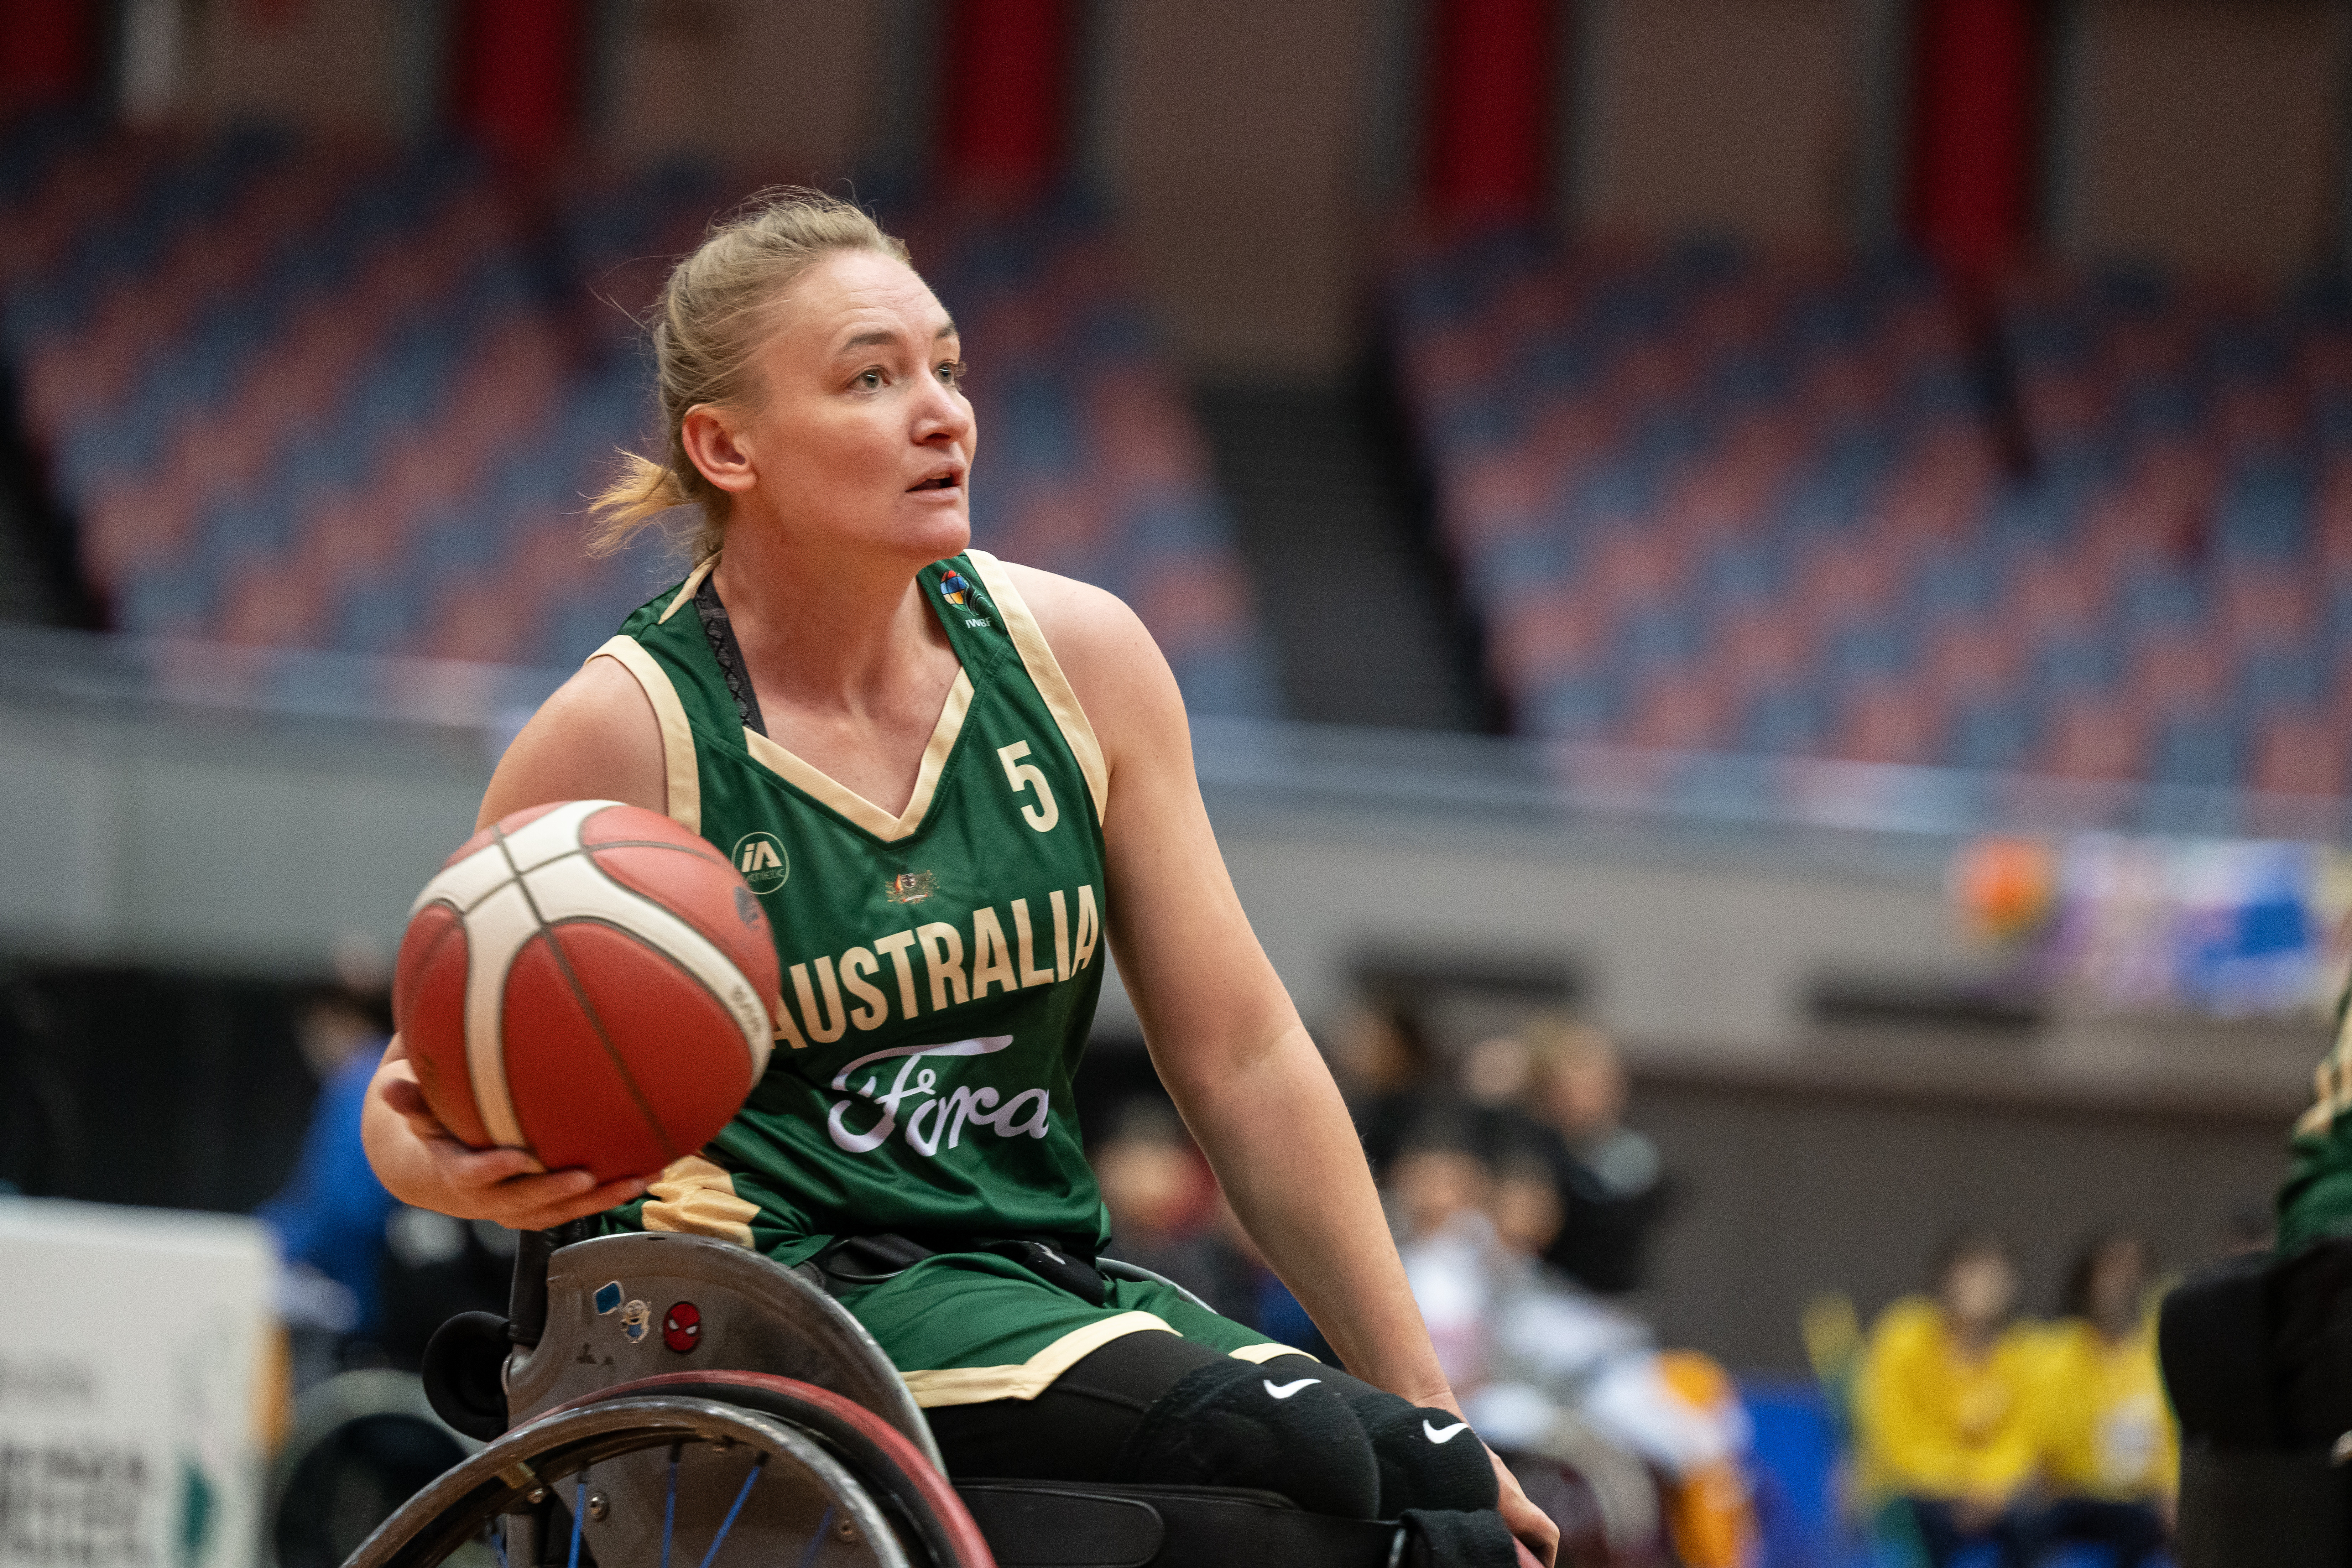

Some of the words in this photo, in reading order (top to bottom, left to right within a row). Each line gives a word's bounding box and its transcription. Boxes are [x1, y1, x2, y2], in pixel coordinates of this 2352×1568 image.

[965, 617, 992, 629] IWBF
[997, 740, 1059, 833] 5
[771, 884, 1099, 1050] AUSTRALIA
